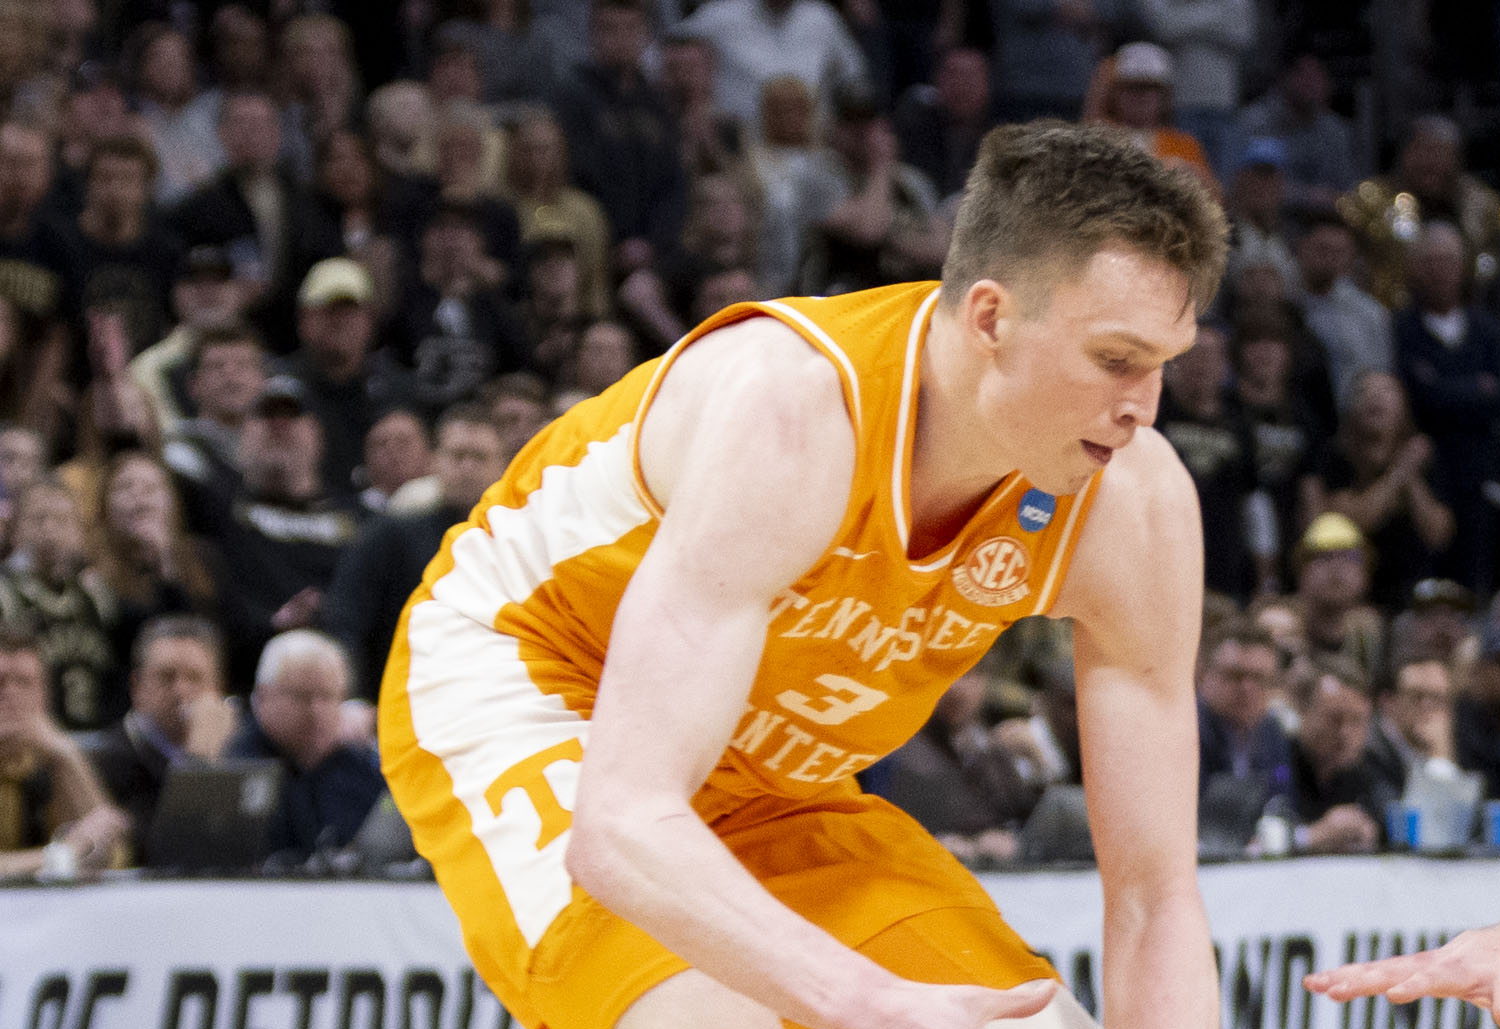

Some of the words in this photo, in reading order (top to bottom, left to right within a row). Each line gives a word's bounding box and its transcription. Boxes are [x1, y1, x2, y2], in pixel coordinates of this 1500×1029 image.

[970, 541, 1026, 589] SEC
[775, 673, 890, 726] 3
[483, 737, 585, 851] T
